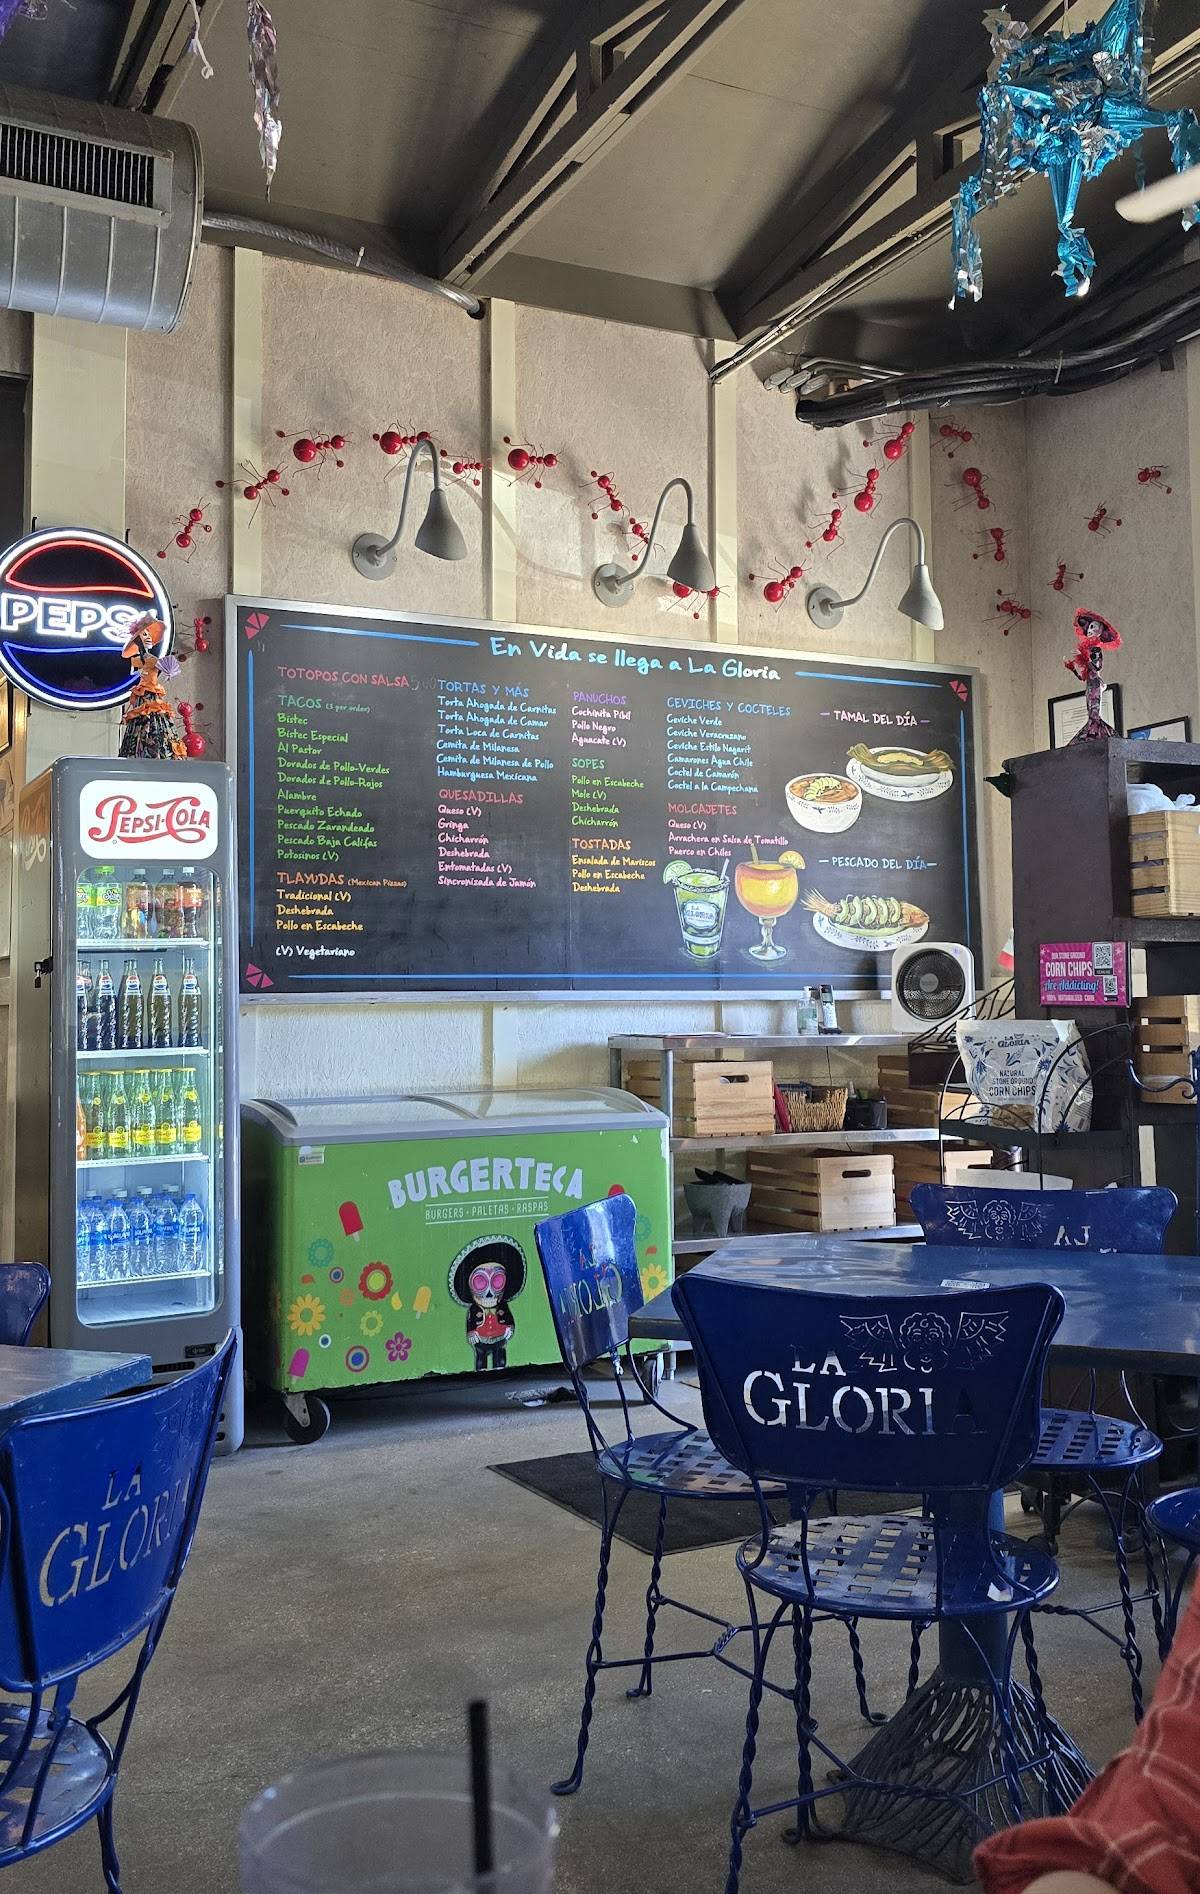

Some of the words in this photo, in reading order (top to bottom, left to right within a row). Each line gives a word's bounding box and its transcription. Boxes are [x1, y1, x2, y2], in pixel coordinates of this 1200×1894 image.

[490, 637, 520, 656] En
[529, 640, 582, 662] Vida
[588, 651, 608, 664] se
[615, 649, 663, 676] llega
[670, 659, 682, 671] a
[688, 658, 716, 674] La
[722, 659, 781, 680] Gloria
[277, 666, 338, 682] TOTOPOS
[342, 672, 367, 684] CON
[371, 674, 410, 688] SALSA
[438, 680, 486, 694] TORTAS
[492, 685, 500, 695] Y
[505, 682, 530, 697] MÁS
[277, 695, 322, 708] TACOS
[574, 692, 627, 704] PANUCHOS
[438, 696, 464, 706] Torta
[466, 698, 506, 712] Ahogada
[508, 702, 518, 712] de
[520, 702, 556, 714] Carnitas
[667, 697, 721, 711] CEVICHES
[738, 702, 791, 716] COCTELES
[277, 713, 308, 724] Bistec
[438, 710, 464, 721] Torta
[466, 712, 506, 726] Ahogada
[508, 715, 518, 726] de
[572, 706, 611, 718] Cochinita
[834, 710, 870, 724] TAMAL
[872, 714, 893, 725] DEL
[896, 711, 918, 726] DÍA
[572, 720, 590, 730] Pollo
[592, 722, 616, 734] Negro
[700, 716, 722, 726] Verde
[277, 728, 308, 740] Bistec
[311, 730, 348, 744] Especial
[438, 724, 464, 735] Torta
[466, 726, 487, 736] Loca
[490, 728, 500, 738] de
[502, 729, 540, 740] Carnitas
[436, 740, 468, 750] Cemita
[470, 740, 480, 750] de
[482, 742, 520, 752] Milanesa
[572, 732, 610, 746] Aguacate
[612, 737, 626, 747] (V)
[277, 742, 288, 753] Al
[292, 743, 322, 754] Pastor
[277, 757, 316, 770] Dorados
[319, 760, 331, 770] de
[436, 754, 468, 764] Cemita
[470, 754, 480, 764] de
[482, 756, 520, 766] Milanesa
[522, 758, 532, 768] de
[534, 758, 554, 769] Pollo
[572, 758, 605, 769] SOPES
[668, 753, 709, 764] Camarones
[438, 766, 494, 782] Hamburguesa
[668, 766, 692, 777] Coctel
[694, 768, 704, 778] de
[277, 772, 316, 784] Dorados
[319, 774, 331, 786] de
[572, 775, 590, 785] Pollo
[604, 777, 644, 788] Escabeche
[668, 780, 692, 791] Coctel
[277, 788, 317, 800] Alambre
[439, 788, 524, 804] QUESADILLAS
[572, 788, 590, 798] Mole
[592, 790, 606, 800] (V)
[327, 806, 362, 818] Echado
[438, 805, 464, 814] Queso
[466, 806, 482, 817] (V)
[572, 802, 620, 814] Deshebrada
[668, 803, 737, 815] MOLCAJETES
[277, 820, 315, 831] Pescado
[317, 820, 374, 833] Zarandeado
[438, 818, 469, 832] Gringa
[668, 820, 692, 829] Queso
[692, 820, 706, 830] (V)
[277, 834, 315, 846] Pescado
[317, 835, 341, 848] Baja
[572, 838, 632, 850] TOSTADAS
[322, 851, 339, 862] (V)
[438, 847, 490, 858] Deshebrada
[668, 847, 694, 856] Puerco
[708, 847, 732, 857] Chiles
[572, 854, 608, 866] Ensalada
[610, 856, 620, 866] de
[622, 856, 656, 866] Mariscos
[832, 856, 878, 868] PESCADO
[882, 858, 902, 869] DEL
[906, 856, 927, 870] DÍA
[438, 861, 494, 872] Entomatadas
[497, 864, 512, 874] (V)
[572, 868, 591, 879] Pollo
[604, 870, 646, 880] Escabeche
[276, 872, 344, 886] TLAYUDAS
[496, 877, 507, 887] de
[572, 882, 620, 892] Deshebrada
[276, 889, 332, 901] Tradicional
[335, 890, 352, 902] (V)
[276, 904, 334, 916] Deshebrada
[276, 920, 298, 930] Pollo
[316, 920, 364, 932] Escabeche
[276, 945, 293, 956] (V)
[296, 945, 356, 960] Vegetariano
[1046, 962, 1066, 977] CORN
[1068, 961, 1093, 977] CHIPS
[998, 1039, 1030, 1048] GLORIA
[989, 1086, 1010, 1097] CORN
[1012, 1085, 1036, 1096] CHIPS
[388, 1158, 582, 1208] BURGERTECA
[426, 1207, 464, 1220] BURGERS
[472, 1203, 509, 1216] PALETAS
[516, 1202, 548, 1214] RASPAS
[791, 1345, 846, 1376] LA
[102, 1465, 143, 1510] LA
